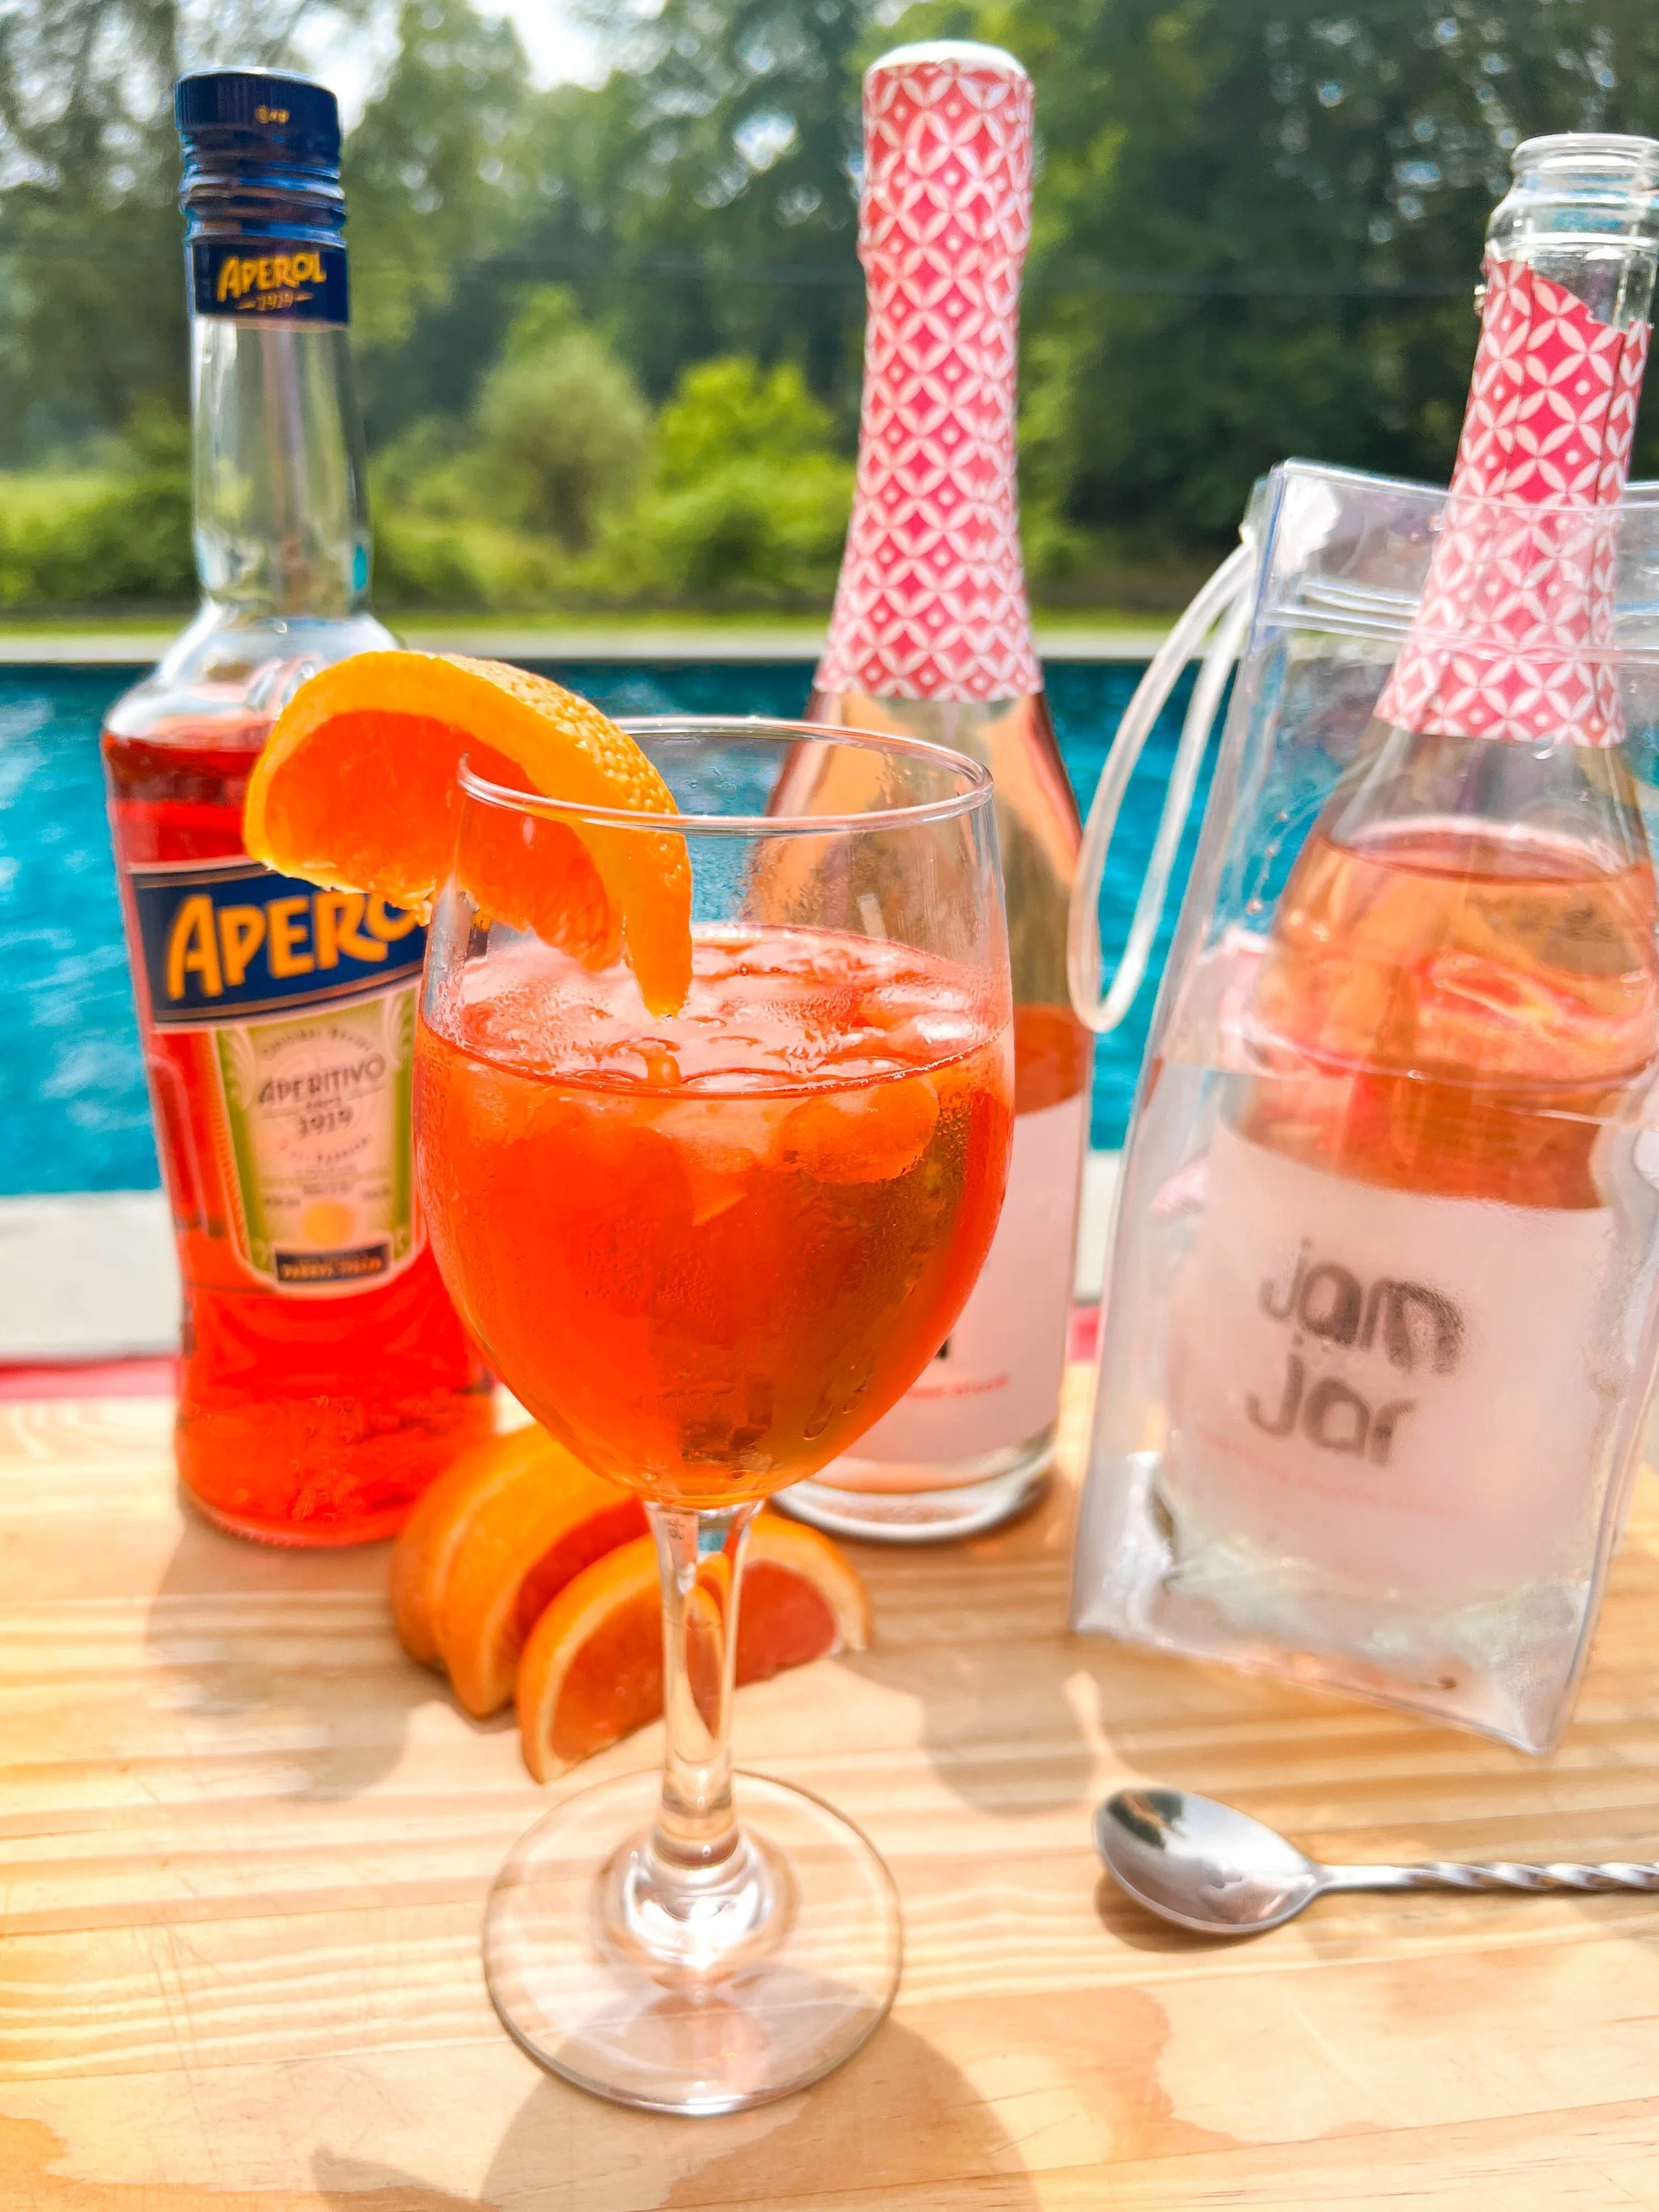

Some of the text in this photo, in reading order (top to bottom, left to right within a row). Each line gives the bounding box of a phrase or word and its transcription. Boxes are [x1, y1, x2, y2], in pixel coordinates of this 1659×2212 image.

[217, 252, 327, 303] APEROL
[166, 891, 419, 1001] APERO
[258, 1053, 386, 1104] APERITIVO
[299, 1106, 354, 1137] 1919
[1260, 1236, 1465, 1374] jam
